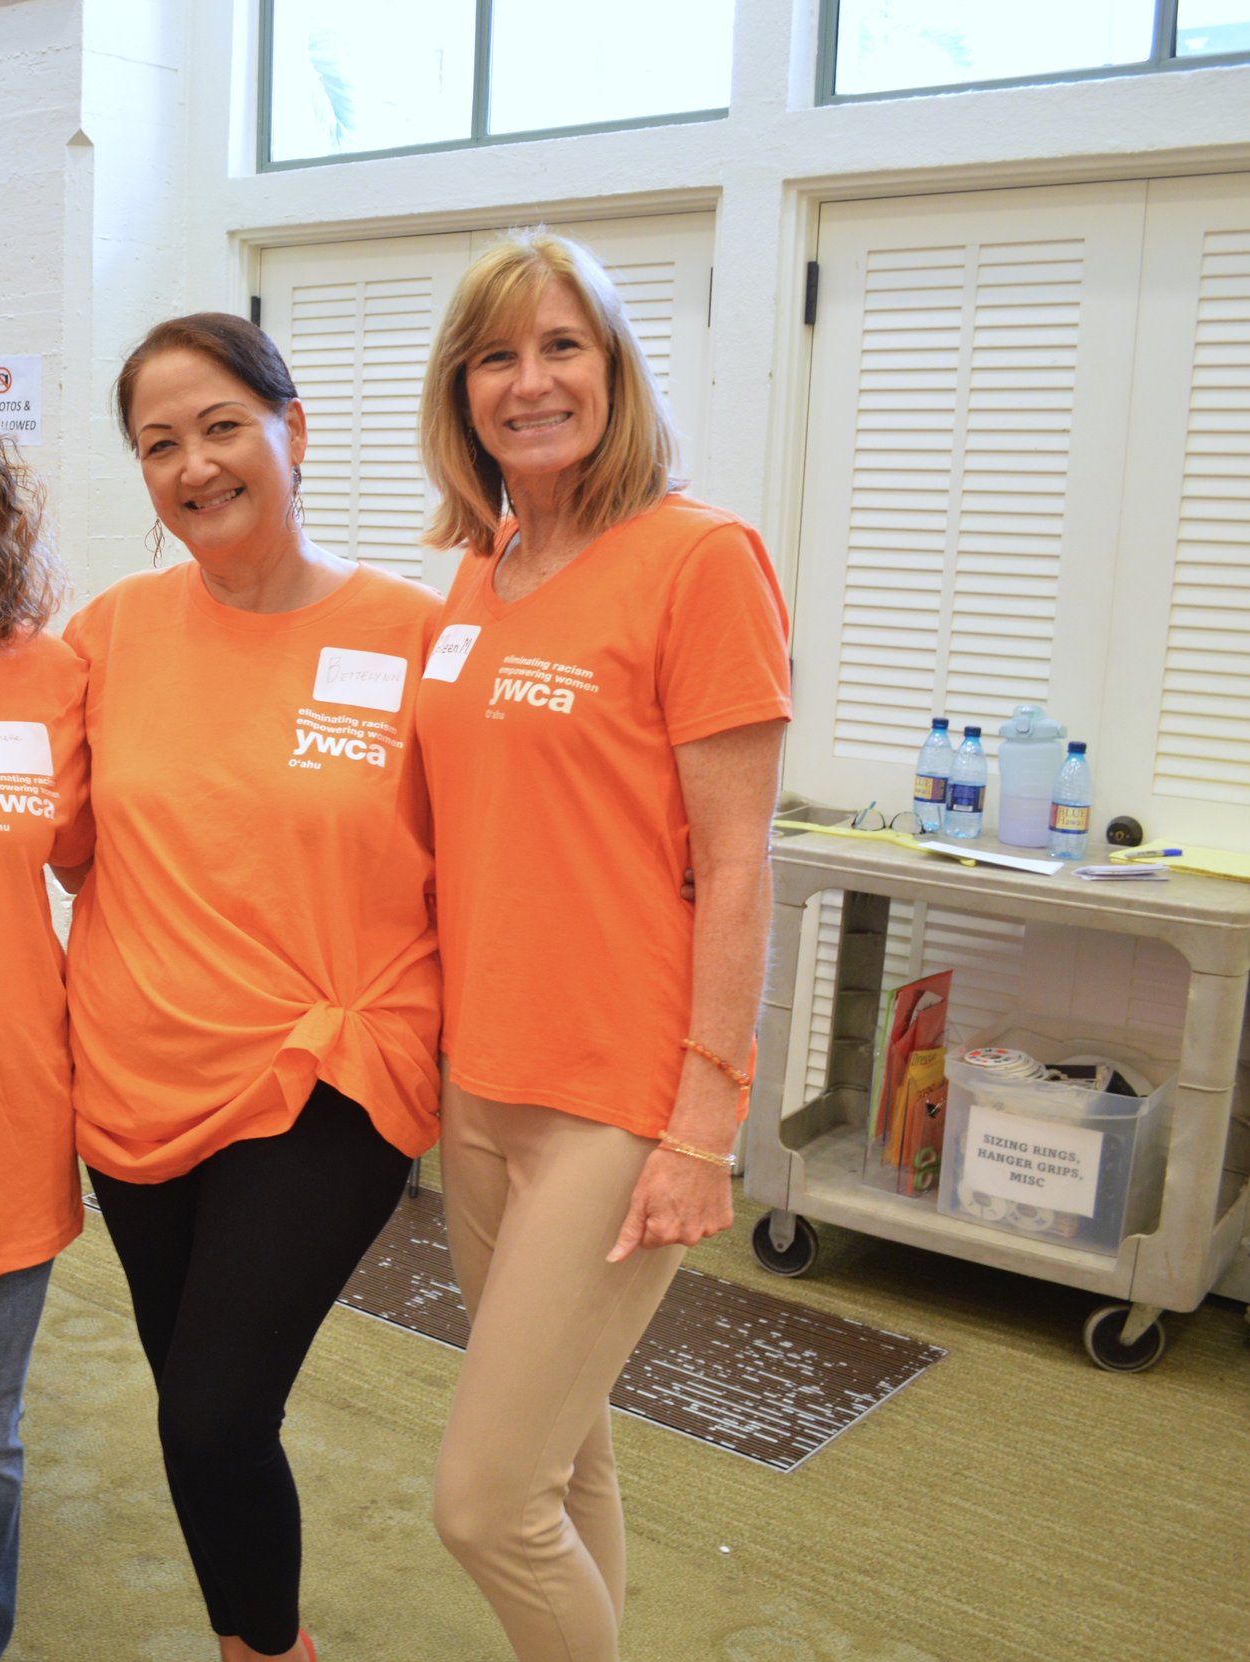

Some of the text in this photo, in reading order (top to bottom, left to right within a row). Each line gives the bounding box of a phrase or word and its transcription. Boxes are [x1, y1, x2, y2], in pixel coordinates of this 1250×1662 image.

[23, 400, 30, 411] &
[498, 666, 599, 693] empowering women
[503, 655, 594, 679] eliminating racism
[489, 677, 575, 714] ywca
[296, 718, 404, 749] empowering women
[298, 708, 398, 735] eliminating racism
[293, 728, 386, 768] ywca
[983, 1134, 1081, 1165] SIZING RINGS,
[977, 1148, 1084, 1181] HANGER GRIPS,
[1009, 1171, 1045, 1188] MISC
